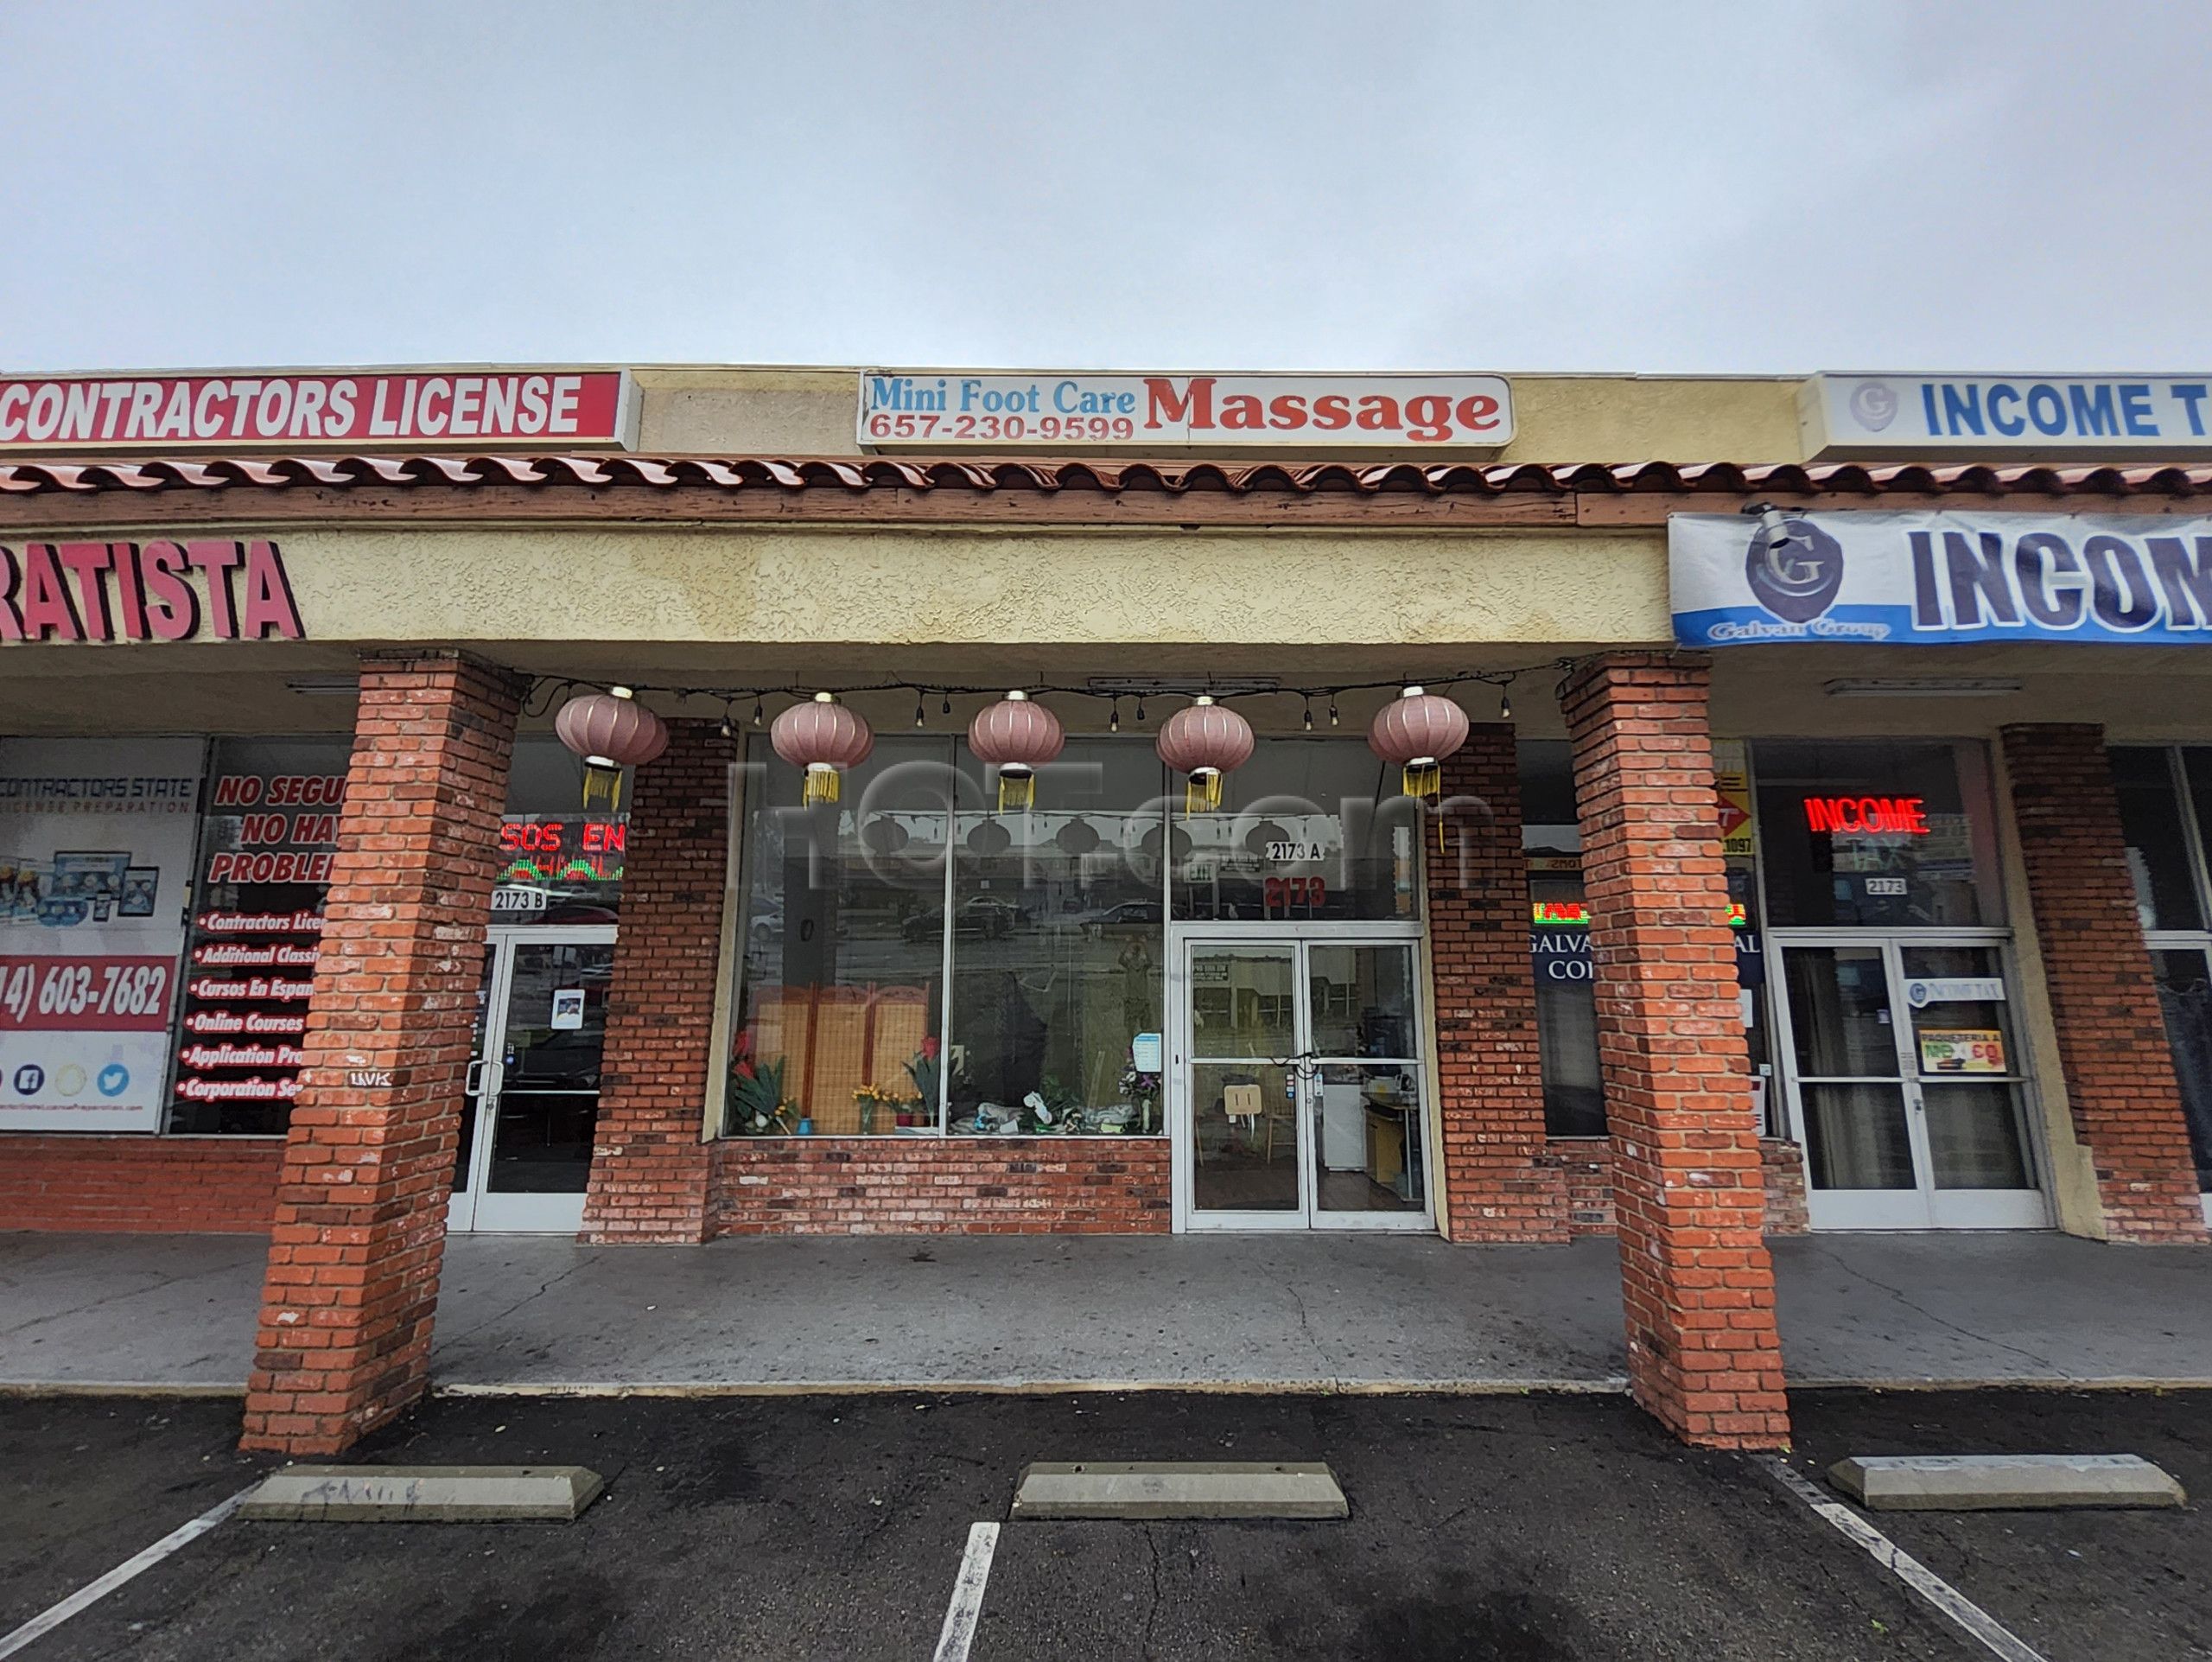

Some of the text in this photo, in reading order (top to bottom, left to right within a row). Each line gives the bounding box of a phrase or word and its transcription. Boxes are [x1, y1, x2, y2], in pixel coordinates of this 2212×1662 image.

[0, 375, 583, 441] CONTRACTORS LICENSE
[871, 378, 1136, 414] Mini Foot Care
[1143, 378, 1501, 443] Massage
[1922, 383, 2160, 436] INCOME
[869, 414, 1135, 442] 657-230-9599
[1709, 619, 1891, 640] Galvan Group
[130, 778, 193, 797] STATE
[214, 775, 346, 806] NO SEGU
[1803, 798, 1931, 833] INCOME
[240, 813, 288, 844] NO
[582, 823, 626, 851] EN
[1272, 843, 1321, 859] 2173 A
[1265, 876, 1326, 907] 2173
[1868, 879, 1904, 893] 2173
[495, 891, 543, 908] 2173 B
[207, 913, 290, 930] Contractors
[201, 946, 276, 963] Additional
[39, 965, 166, 1015] 603-7682
[199, 979, 247, 997] Cursos
[250, 979, 268, 997] En
[194, 1012, 304, 1031] Online Courses
[189, 1046, 275, 1067] Application
[186, 1078, 276, 1099] Corporation
